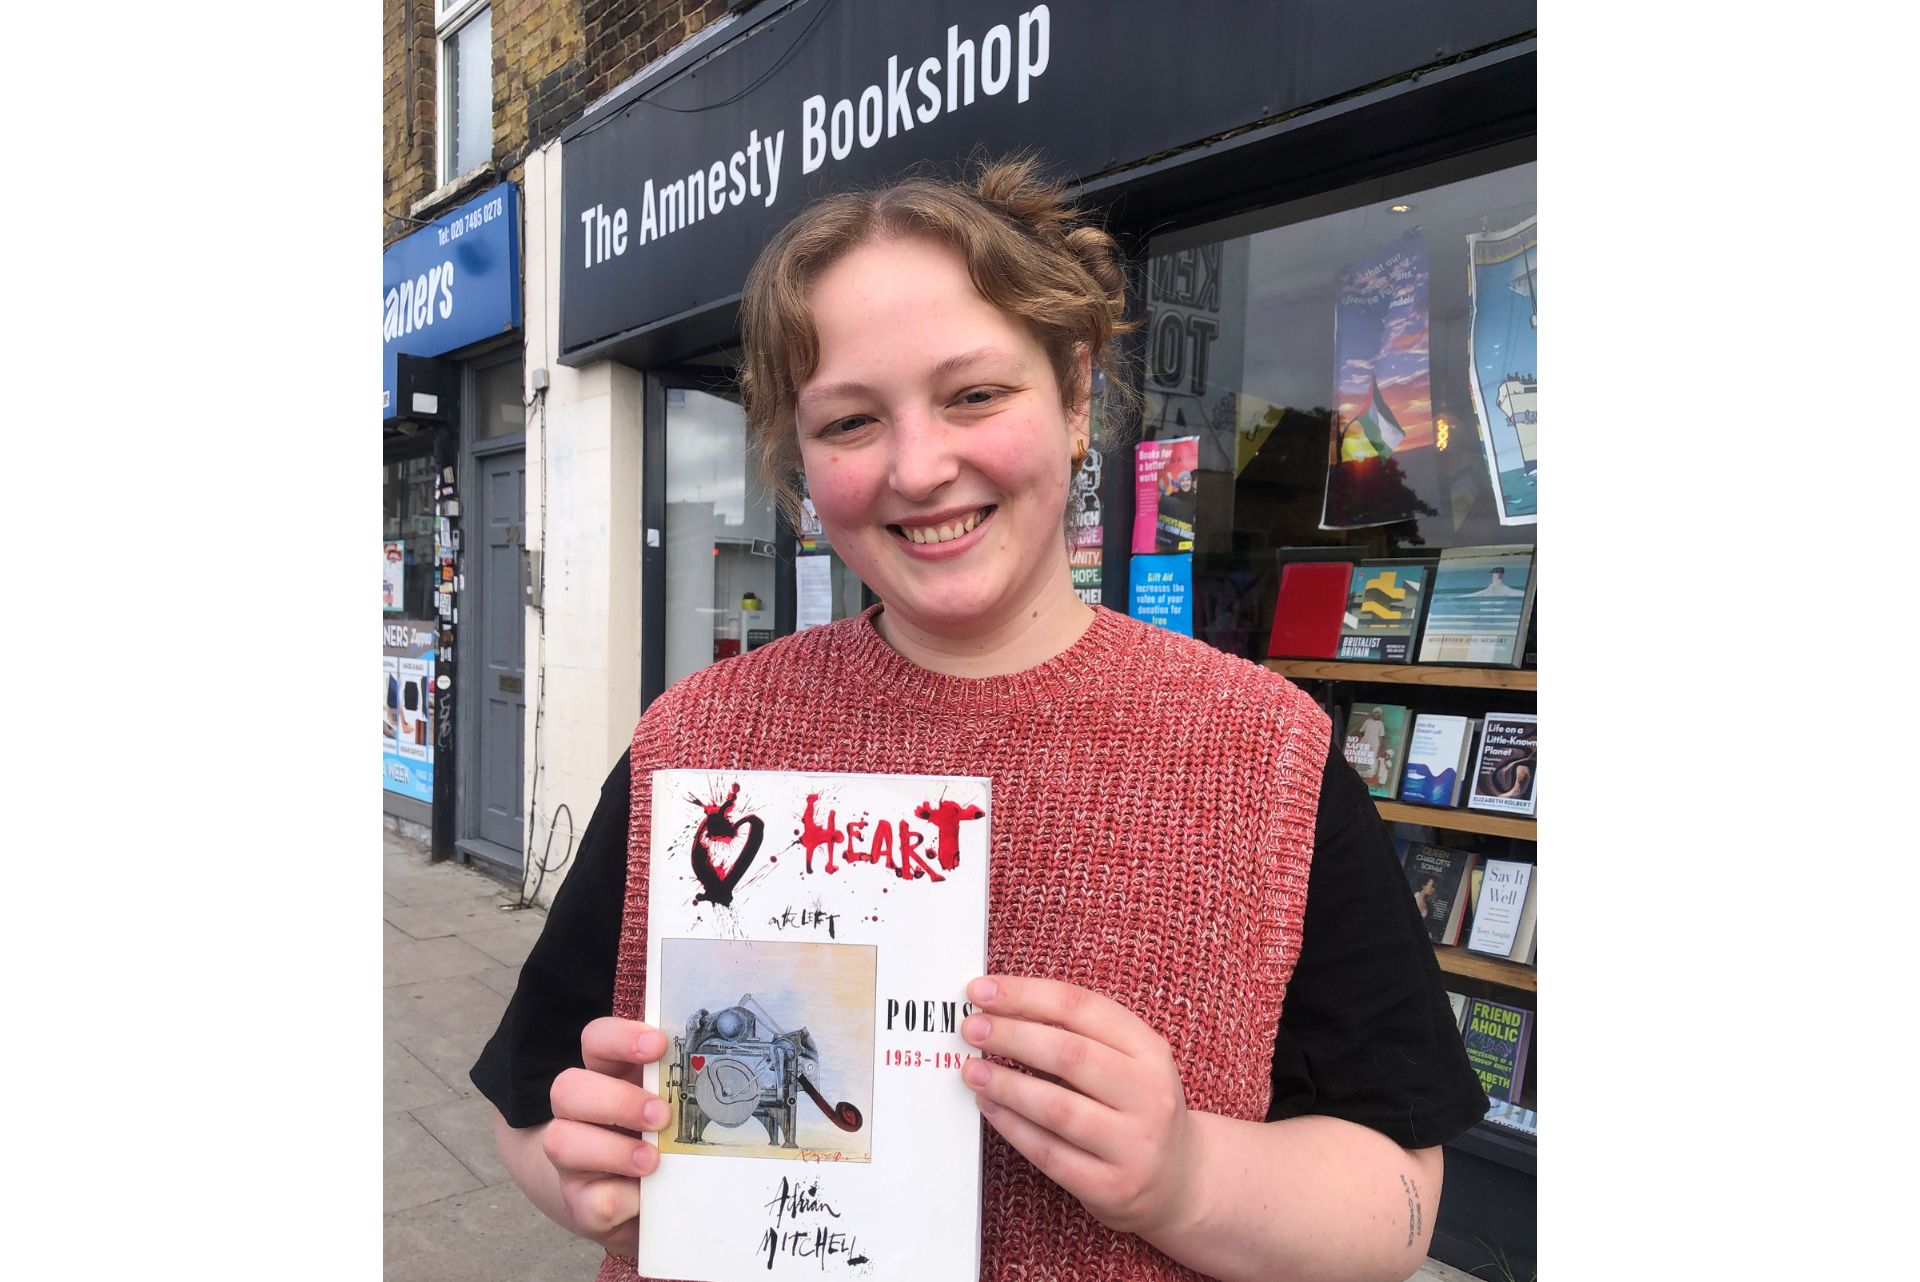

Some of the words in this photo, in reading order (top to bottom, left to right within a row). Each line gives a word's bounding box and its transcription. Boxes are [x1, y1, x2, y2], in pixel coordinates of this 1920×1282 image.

[581, 203, 628, 269] The
[639, 128, 786, 247] Amnesty
[801, 3, 1052, 175] Bookshop
[451, 218, 464, 240] 020
[465, 208, 483, 232] 7485
[484, 197, 503, 223] 0278
[1139, 449, 1160, 460] Books
[1161, 448, 1173, 458] for
[1145, 460, 1166, 471] better
[1139, 472, 1158, 483] world
[1070, 550, 1102, 565] UNITY.
[1071, 569, 1102, 584] HOPE.
[1148, 572, 1161, 582] Gift
[1162, 572, 1174, 582] Aid
[1136, 584, 1171, 593] increases
[1173, 583, 1185, 593] the
[1136, 594, 1155, 603] value
[1157, 594, 1165, 603] of
[1167, 595, 1184, 605] your
[1138, 605, 1168, 615] donation
[1171, 605, 1182, 615] for
[1152, 616, 1167, 626] free
[384, 624, 409, 648] NERS
[1342, 636, 1381, 649] BRUTALIST
[1340, 646, 1370, 657] BRITAIN
[1488, 723, 1504, 733] Life
[1484, 745, 1512, 757] Planet
[1504, 799, 1531, 808] KOLBERT
[798, 793, 986, 883] HEART
[1489, 867, 1511, 887] Say
[1515, 869, 1524, 885] It
[1489, 887, 1517, 905] Well
[1473, 1002, 1521, 1027] FRIEND
[1470, 1018, 1518, 1043] AHOLIC
[884, 1049, 971, 1070] 1953-198
[756, 1226, 869, 1270] MITCHELL
